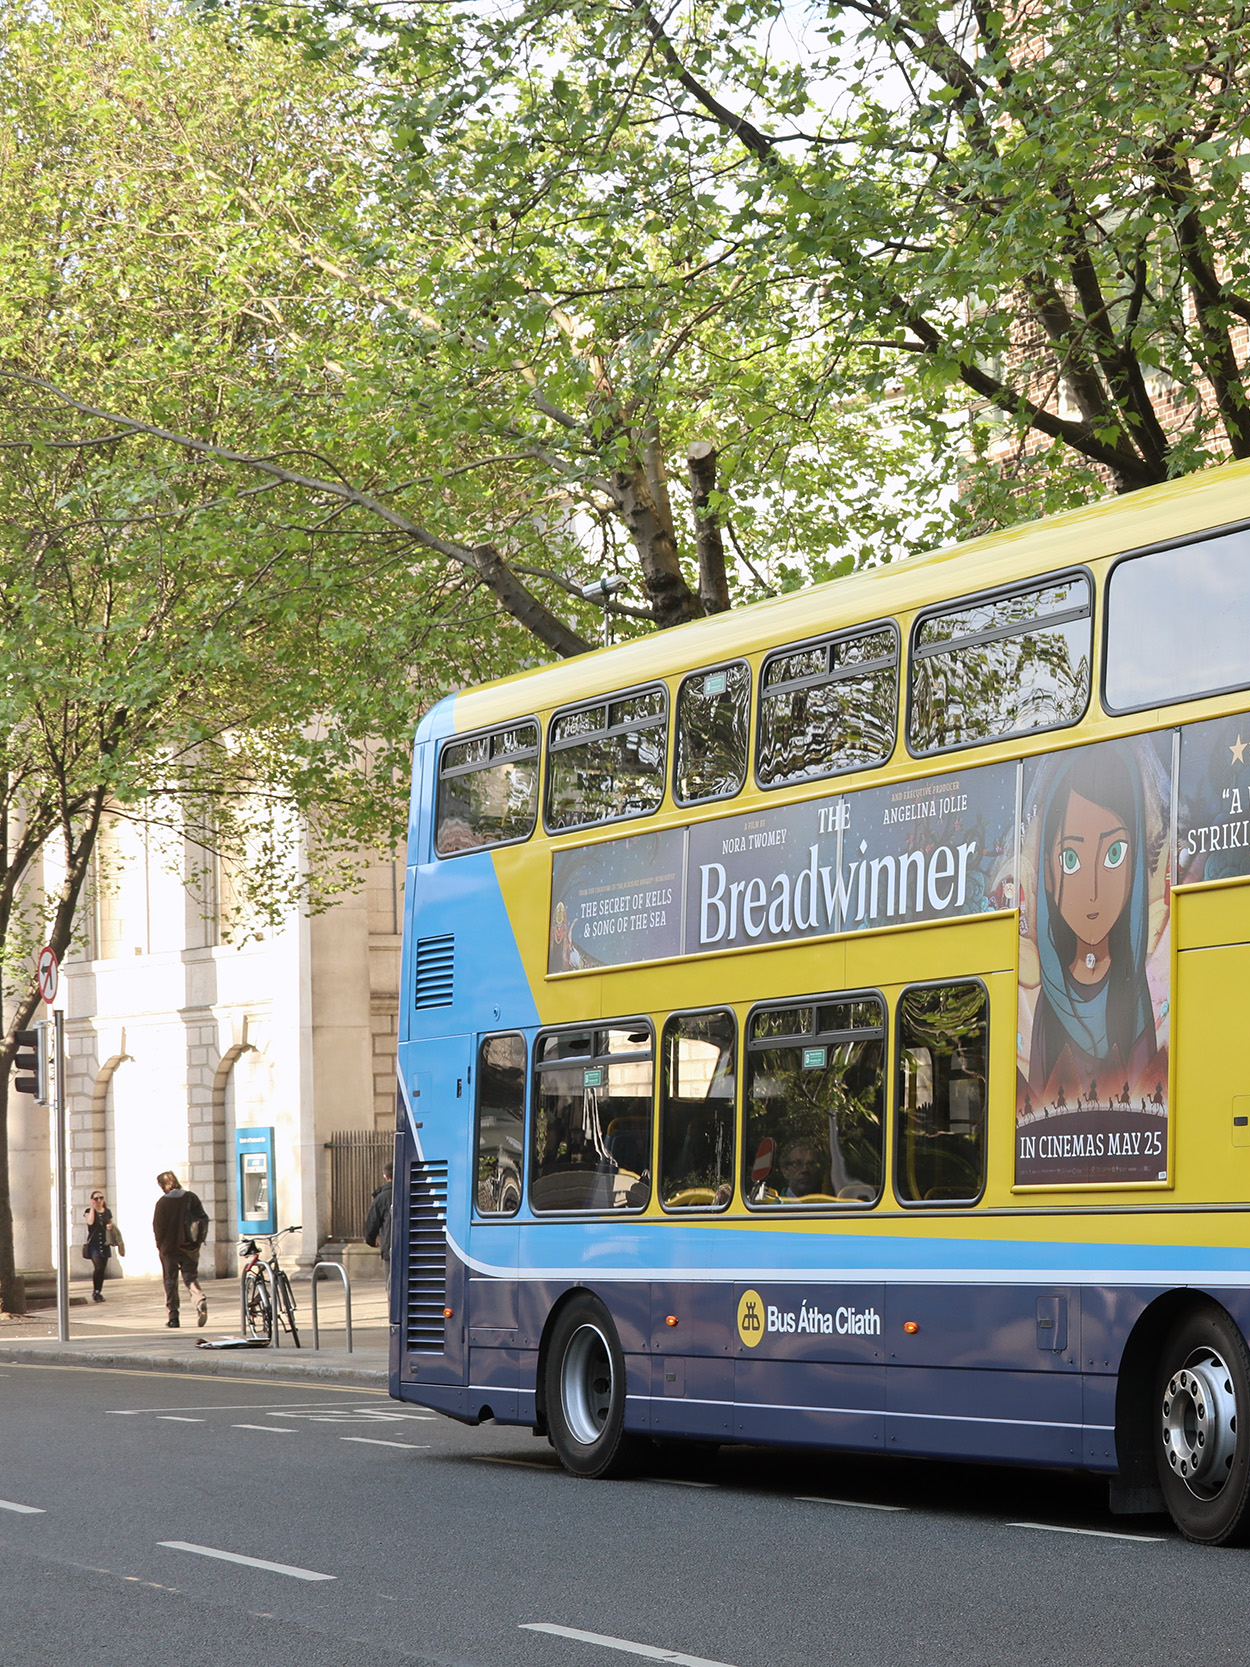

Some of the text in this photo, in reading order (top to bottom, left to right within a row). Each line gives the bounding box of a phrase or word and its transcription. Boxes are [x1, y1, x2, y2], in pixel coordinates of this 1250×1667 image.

[903, 786, 932, 799] EXECUTIVE
[932, 781, 960, 794] PRODUCER
[818, 803, 851, 834] THE
[882, 794, 968, 825] ANGELINA JOLIE
[722, 828, 787, 855] NORA TWOMEY
[580, 888, 672, 919] THE SECRET OF KELLS
[699, 839, 976, 944] Breadwinner
[583, 910, 667, 938] & SONG OF THE SEA
[1020, 1131, 1162, 1159] IN CINEMAS MAY 25
[767, 1299, 881, 1335] Bus Átha Cliath
